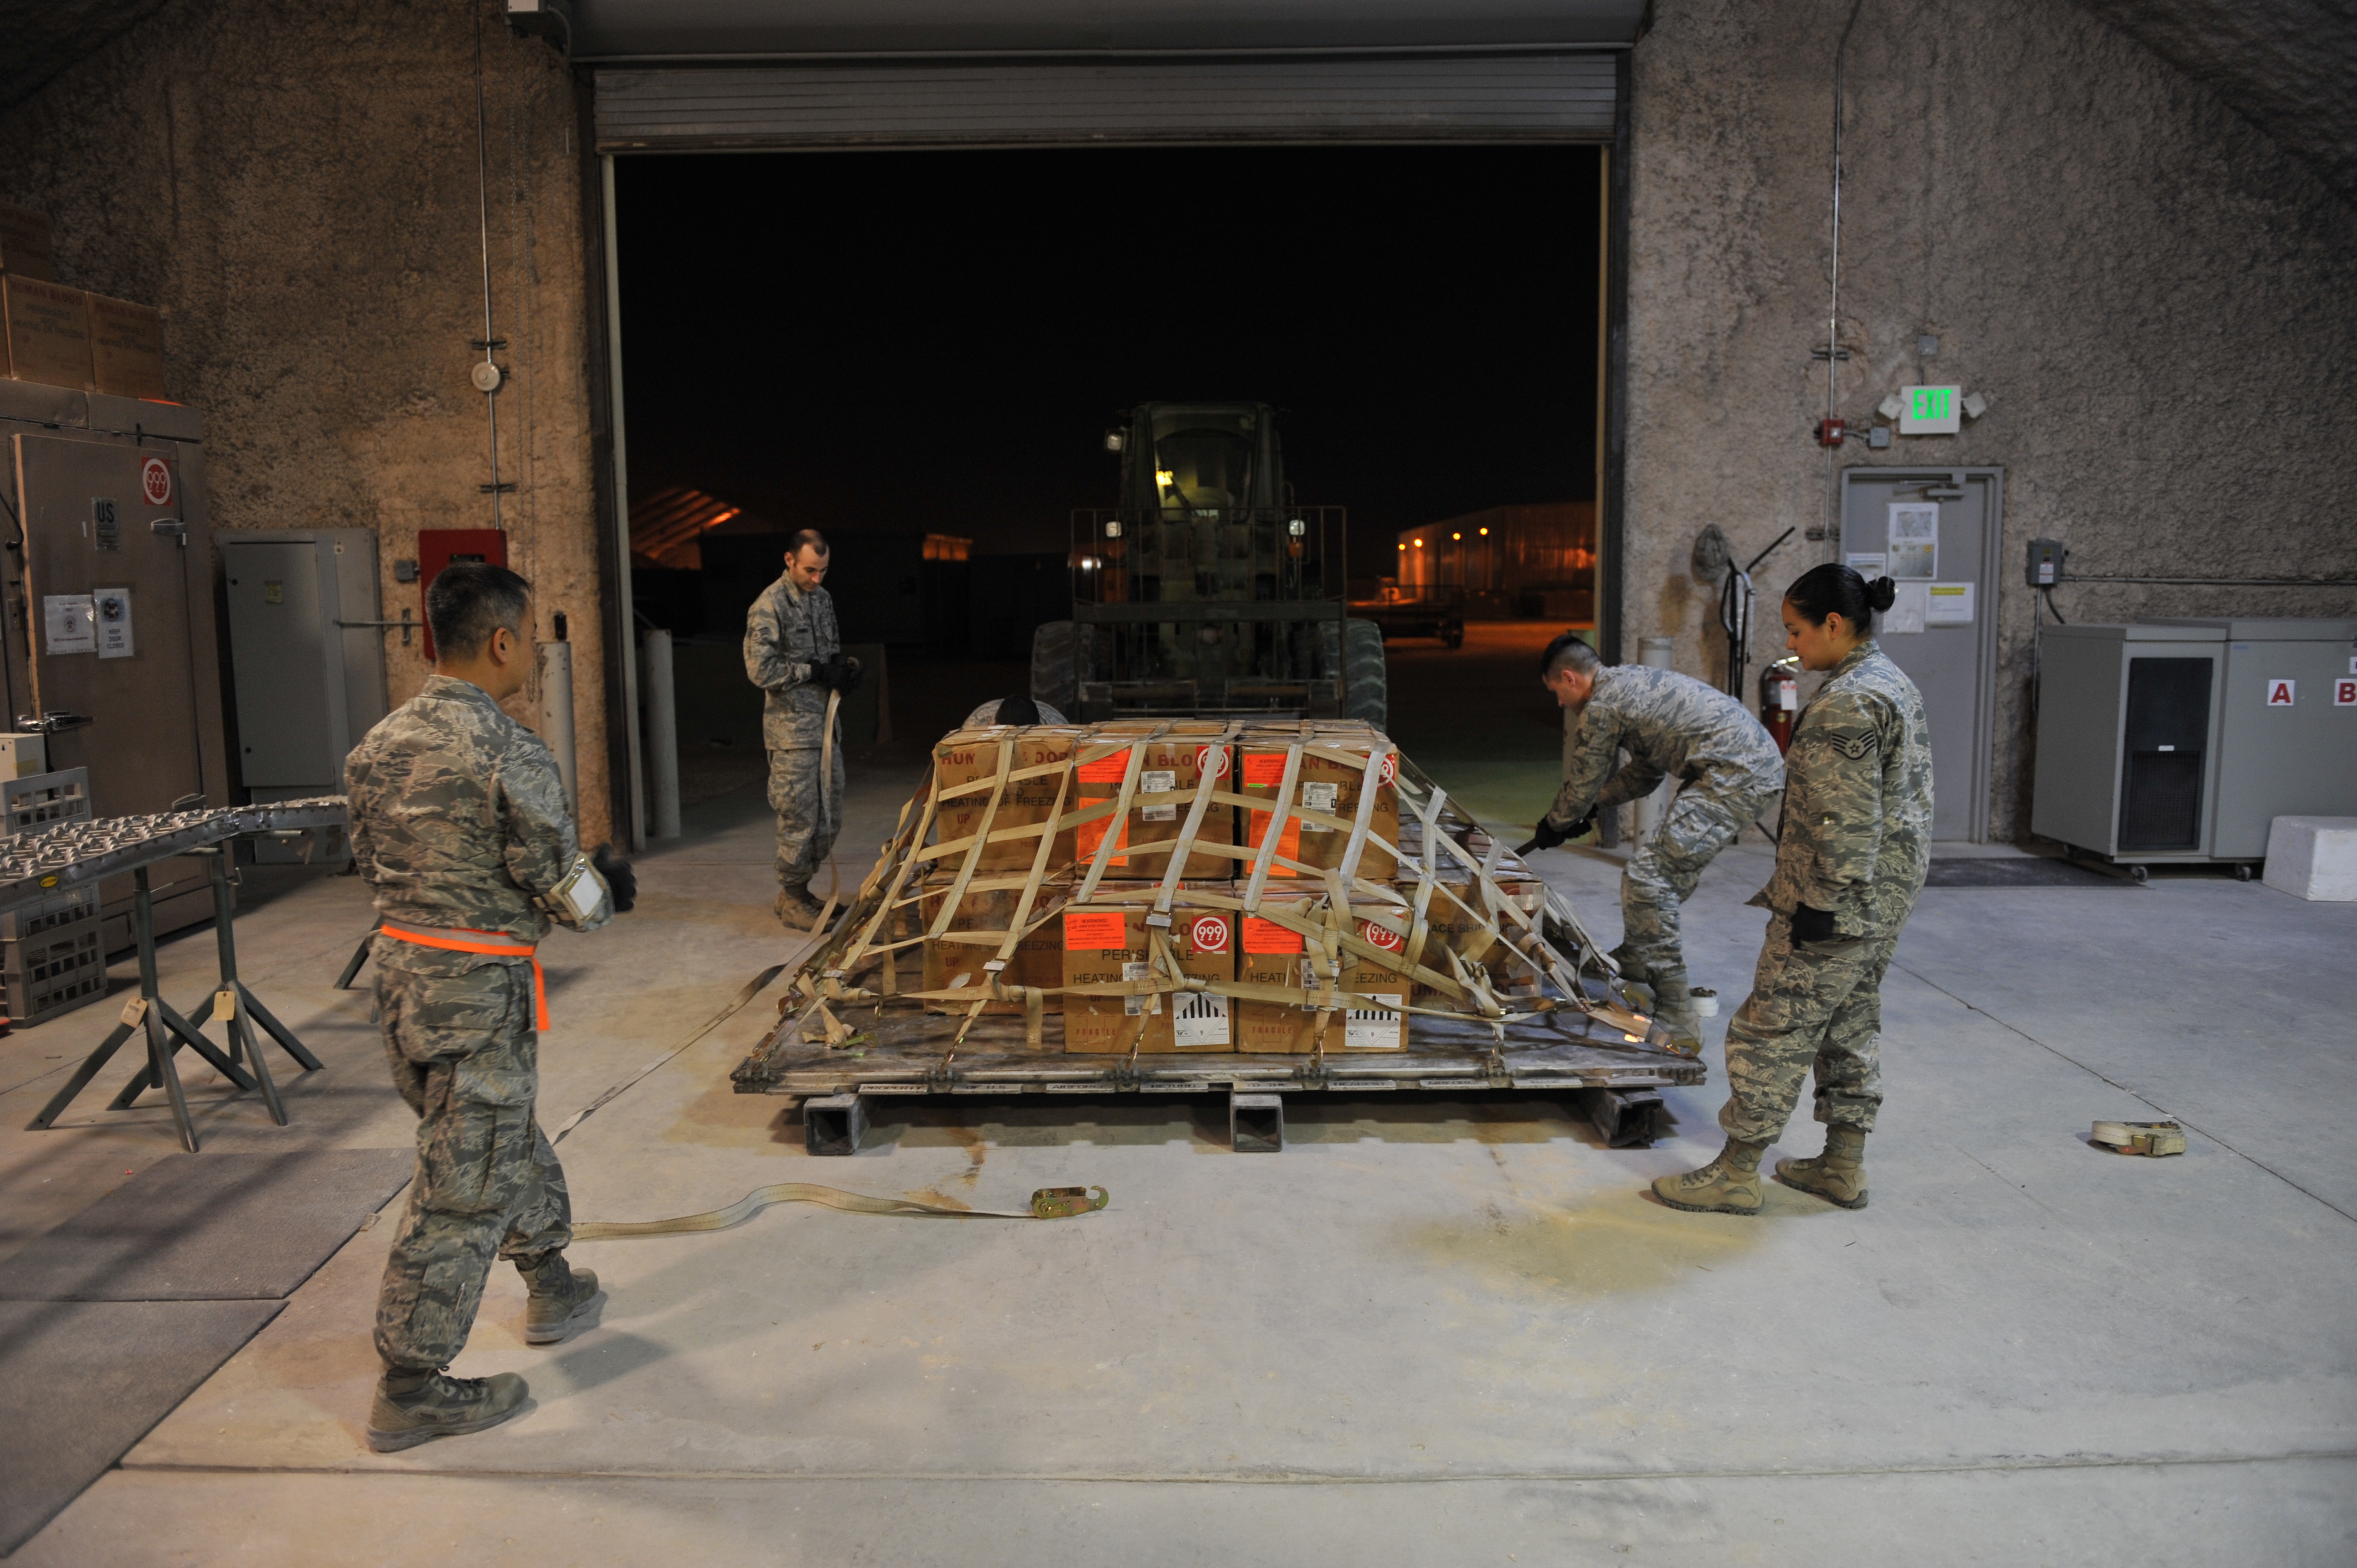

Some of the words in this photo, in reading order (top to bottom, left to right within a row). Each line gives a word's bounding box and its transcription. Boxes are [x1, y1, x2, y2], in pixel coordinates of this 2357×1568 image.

[1913, 389, 1952, 420] EXIT
[147, 471, 166, 493] 999
[96, 502, 115, 523] US
[2271, 683, 2292, 703] A
[2338, 682, 2357, 703] B
[957, 813, 970, 824] UP
[1198, 925, 1223, 941] 999
[1371, 925, 1396, 941] 999
[945, 957, 959, 967] UP
